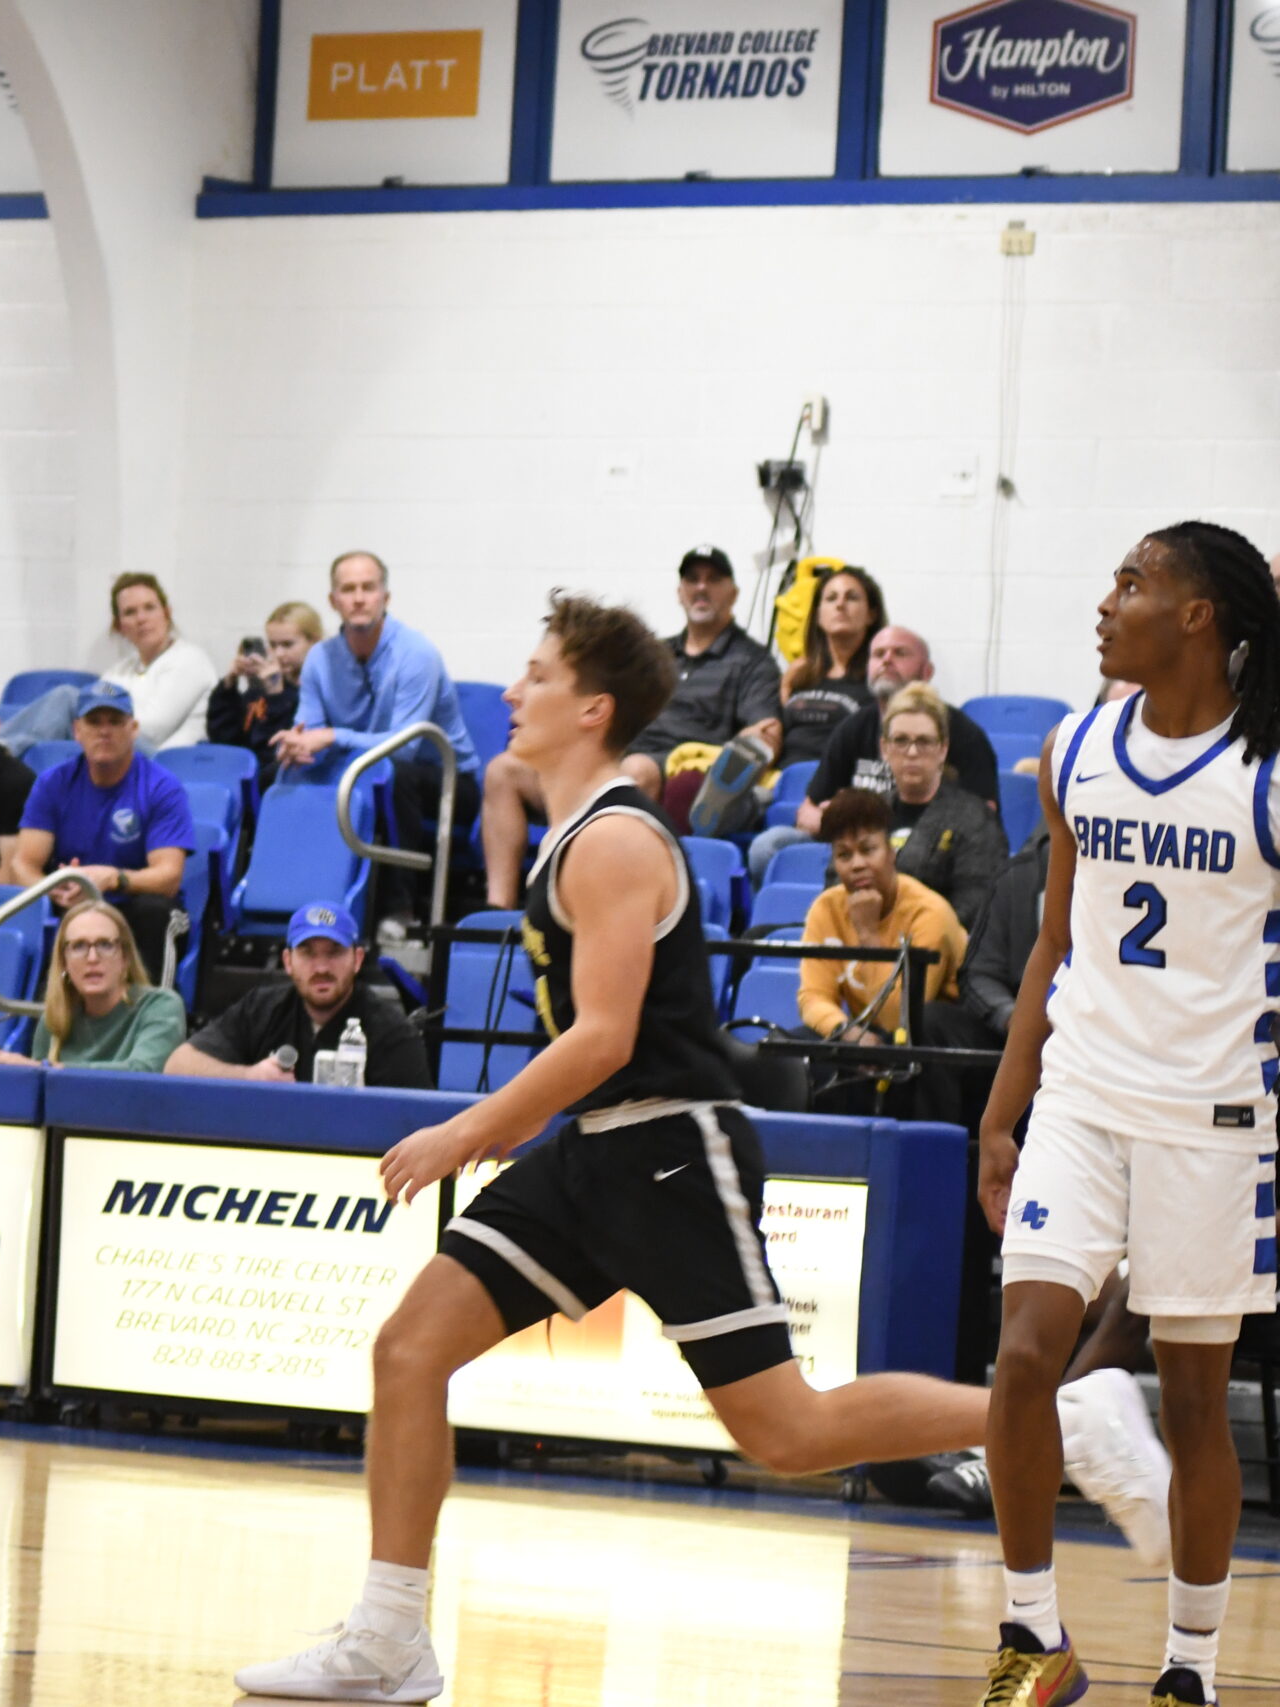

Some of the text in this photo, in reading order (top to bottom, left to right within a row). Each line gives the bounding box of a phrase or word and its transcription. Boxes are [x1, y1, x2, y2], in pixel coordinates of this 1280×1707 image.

[646, 28, 820, 57] BREVARD COLLEGE
[941, 25, 1125, 82] Hampton
[330, 58, 458, 93] PLATT
[637, 58, 811, 101] TORNADOS
[991, 81, 1072, 99] by HILTON
[1073, 815, 1236, 874] BREVARD
[1119, 880, 1167, 969] 2
[101, 1180, 395, 1235] MICHELIN
[762, 1202, 849, 1221] estaurant
[95, 1244, 398, 1286] CHARLIE'S TIRE CENTER
[122, 1279, 373, 1317] 177 N CALDWELL ST
[245, 1321, 285, 1343] NC
[293, 1323, 370, 1349] 28712
